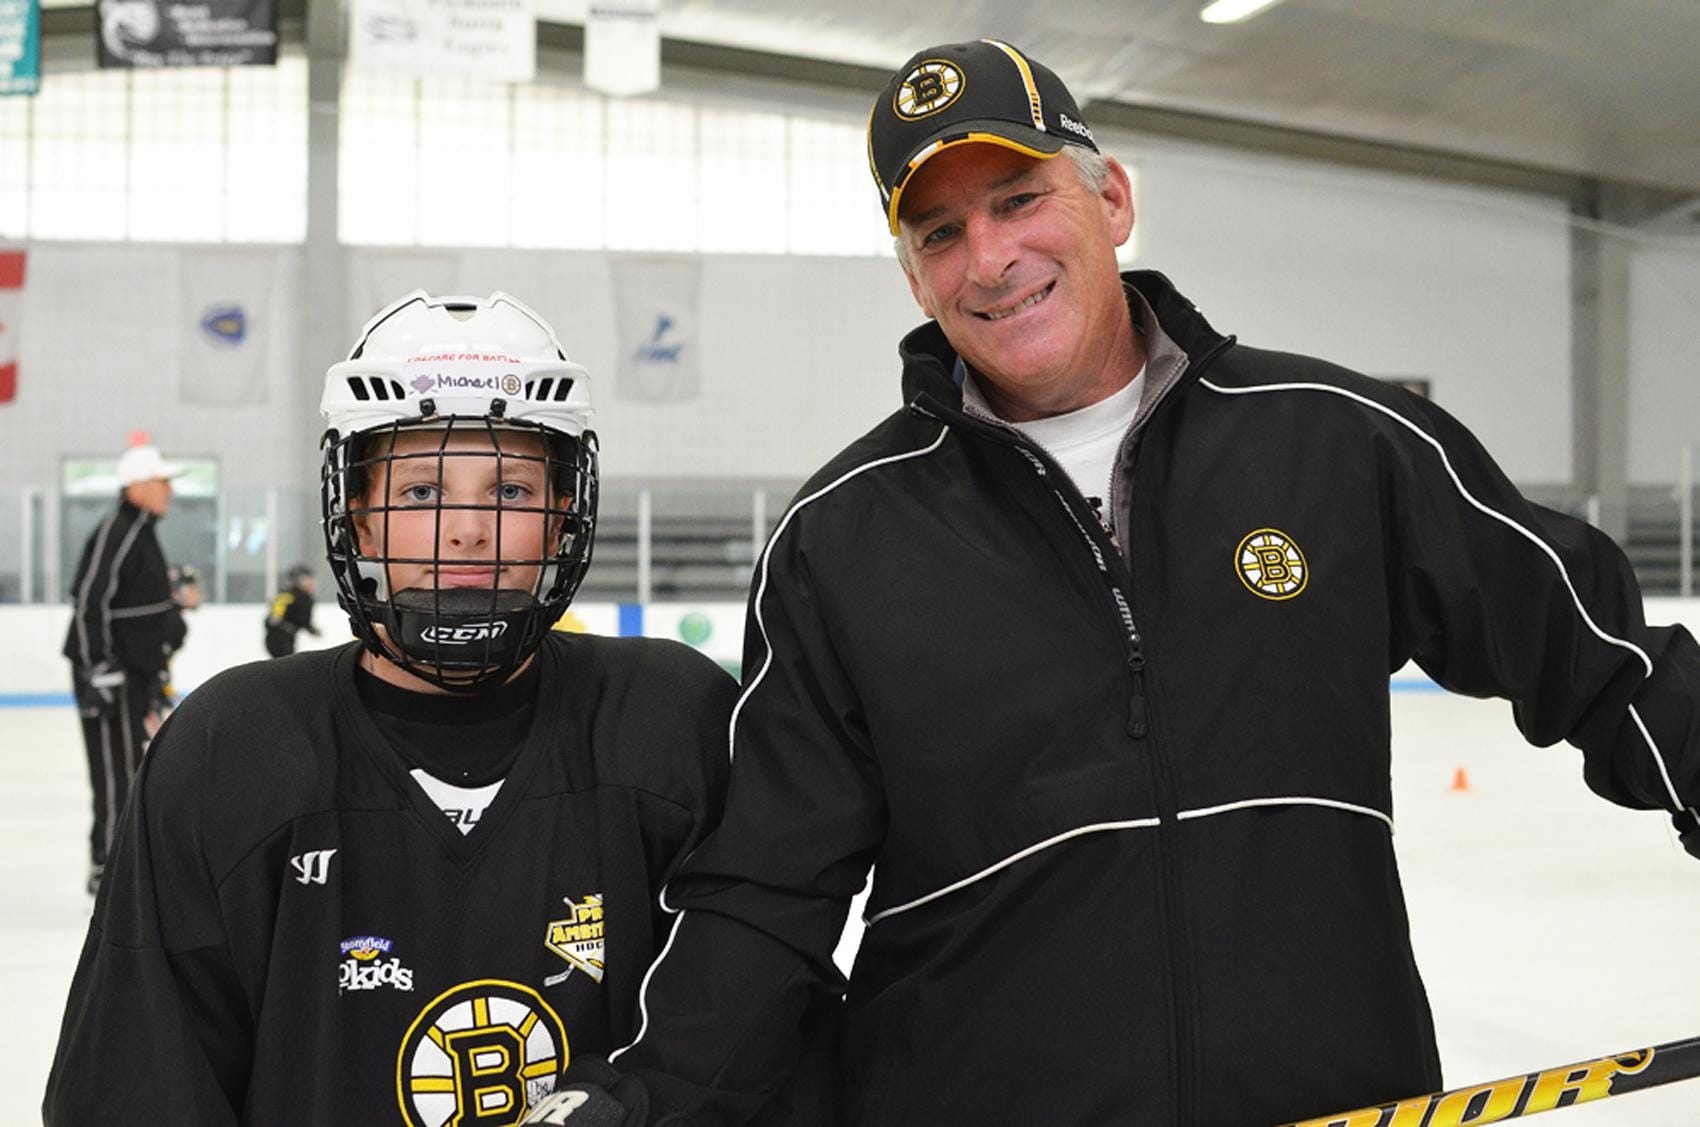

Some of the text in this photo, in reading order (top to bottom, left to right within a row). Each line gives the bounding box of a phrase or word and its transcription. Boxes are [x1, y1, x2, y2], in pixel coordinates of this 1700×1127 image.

[458, 353, 479, 361] FOR
[1254, 545, 1293, 585] B
[426, 624, 503, 642] CCM
[445, 1024, 527, 1127] B
